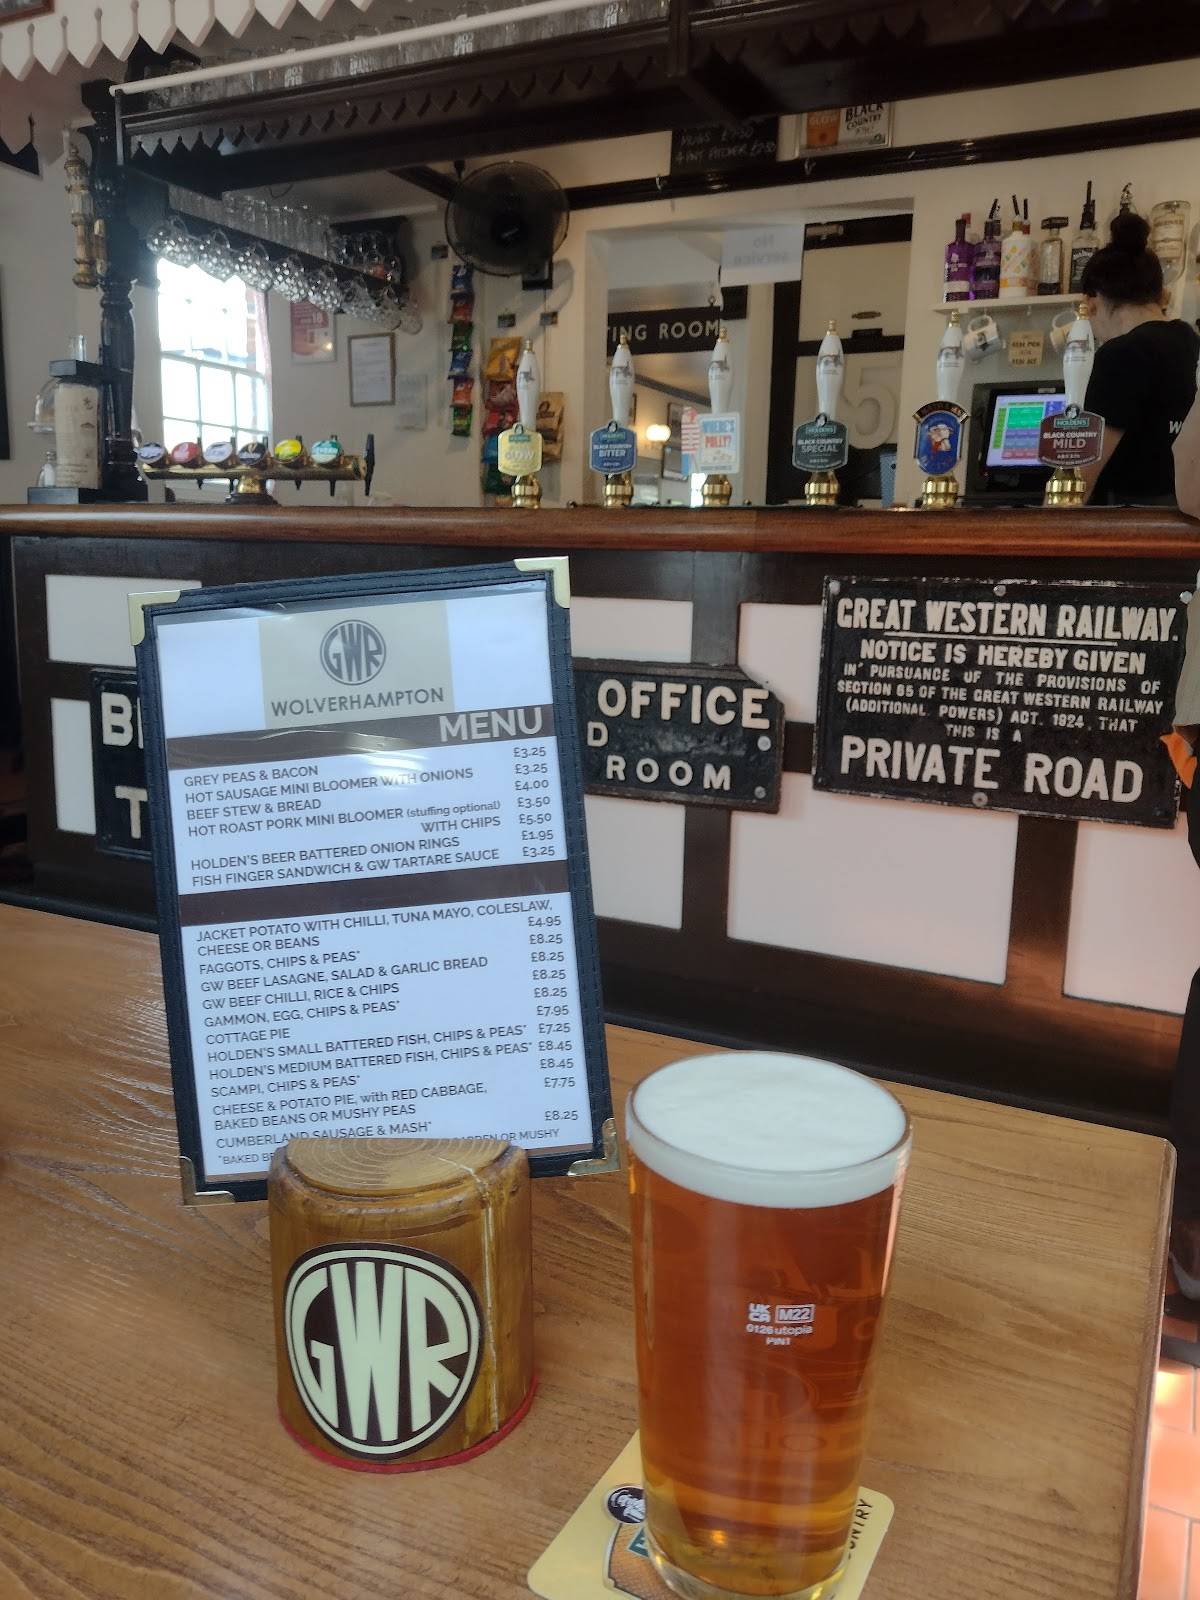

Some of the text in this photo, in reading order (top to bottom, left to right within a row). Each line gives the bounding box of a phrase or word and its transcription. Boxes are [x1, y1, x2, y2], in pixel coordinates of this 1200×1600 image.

[845, 102, 884, 123] BLACK
[846, 114, 882, 131] COUNTRY
[659, 320, 720, 339] ROOM
[599, 449, 625, 457] BITTER
[801, 444, 839, 453] SPECIAL
[1053, 438, 1087, 449] MILD
[837, 598, 1178, 642] GREAT WESTERN RAILWAY.
[323, 622, 385, 684] GWR
[860, 639, 1146, 675] NOTICE IS HEREBY GIVEN
[870, 664, 950, 682] PURSUANCE
[964, 670, 981, 683] OF
[996, 672, 1024, 687] THE
[1037, 672, 1127, 692] PROVISIONS
[1141, 680, 1161, 695] OF
[271, 687, 444, 717] WOLVERHAMPTON
[598, 679, 770, 730] OFFICE
[837, 681, 891, 695] SECTION
[919, 685, 937, 699] OF
[942, 687, 967, 701] THE
[973, 689, 1018, 706] GREAT
[1024, 692, 1091, 709] WESTERN
[1098, 697, 1163, 715] RAILWAY
[438, 707, 544, 742] MENU
[846, 698, 927, 717] (ADDITIONAL
[939, 706, 1003, 726] POWERS)
[1099, 717, 1138, 733] THAT
[946, 725, 1022, 743] THIS IS A
[513, 746, 546, 759] £3.25
[183, 764, 318, 787] GREY PEAS BACON
[606, 755, 731, 791] ROOM
[841, 735, 1144, 804] PRIVATE ROAD
[185, 791, 213, 804] HOT
[216, 785, 278, 801] SAUSAGE
[280, 782, 310, 796] MINI
[312, 776, 381, 793] BLOOMER
[419, 767, 473, 782] ONIONS
[514, 779, 549, 792] £4.00
[186, 798, 322, 821] BEEF STEW BREAD
[516, 795, 551, 809] £3.50
[188, 824, 216, 837] HOT
[219, 820, 263, 834] ROAST
[264, 816, 303, 830] PORK
[305, 813, 335, 827] MINI
[337, 807, 407, 824] BLOOMER
[420, 815, 501, 833] WITH CHIPS
[518, 812, 552, 825] £5.50
[520, 829, 554, 841] £1.95
[190, 836, 460, 871] HOLDEN'S BEER BATTERED ONION RINGS
[192, 848, 500, 887] FISH FINGER SANDWICH GW TARTARE SAUCE
[195, 899, 552, 942] JACKET POTATO WITH CHILLI, TUNA MAYO, COLESLAW,
[527, 915, 562, 928] £4.95
[529, 933, 563, 945] £8.25
[199, 959, 264, 975] FAGGOTS,
[266, 954, 308, 969] CHIPS
[200, 956, 488, 992] GW BEEF LASAGNE, SALAD GARLIC BREAD
[203, 1012, 270, 1027] GAMMON,
[272, 1009, 304, 1022] EGG,
[305, 1005, 348, 1019] CHIPS
[536, 1003, 570, 1017] £7.95
[205, 1027, 291, 1045] COTTAGE PIE
[537, 1022, 571, 1036] £7.25
[207, 1047, 275, 1062] HOLDEN'S
[276, 1042, 324, 1057] SMALL
[324, 1036, 394, 1053] BATTERED
[396, 1033, 433, 1046] FISH,
[432, 1028, 474, 1043] CHIPS
[537, 1039, 572, 1051] £8.45
[544, 1076, 576, 1088] £7.75
[212, 1082, 487, 1116] CHEESE POTATO PIE, with RED CABBAGE,
[501, 1132, 517, 1141] OR
[519, 1128, 560, 1140] MUSHY
[779, 1308, 811, 1321] M22
[291, 1261, 468, 1441] GWR
[765, 1337, 791, 1345] PINT
